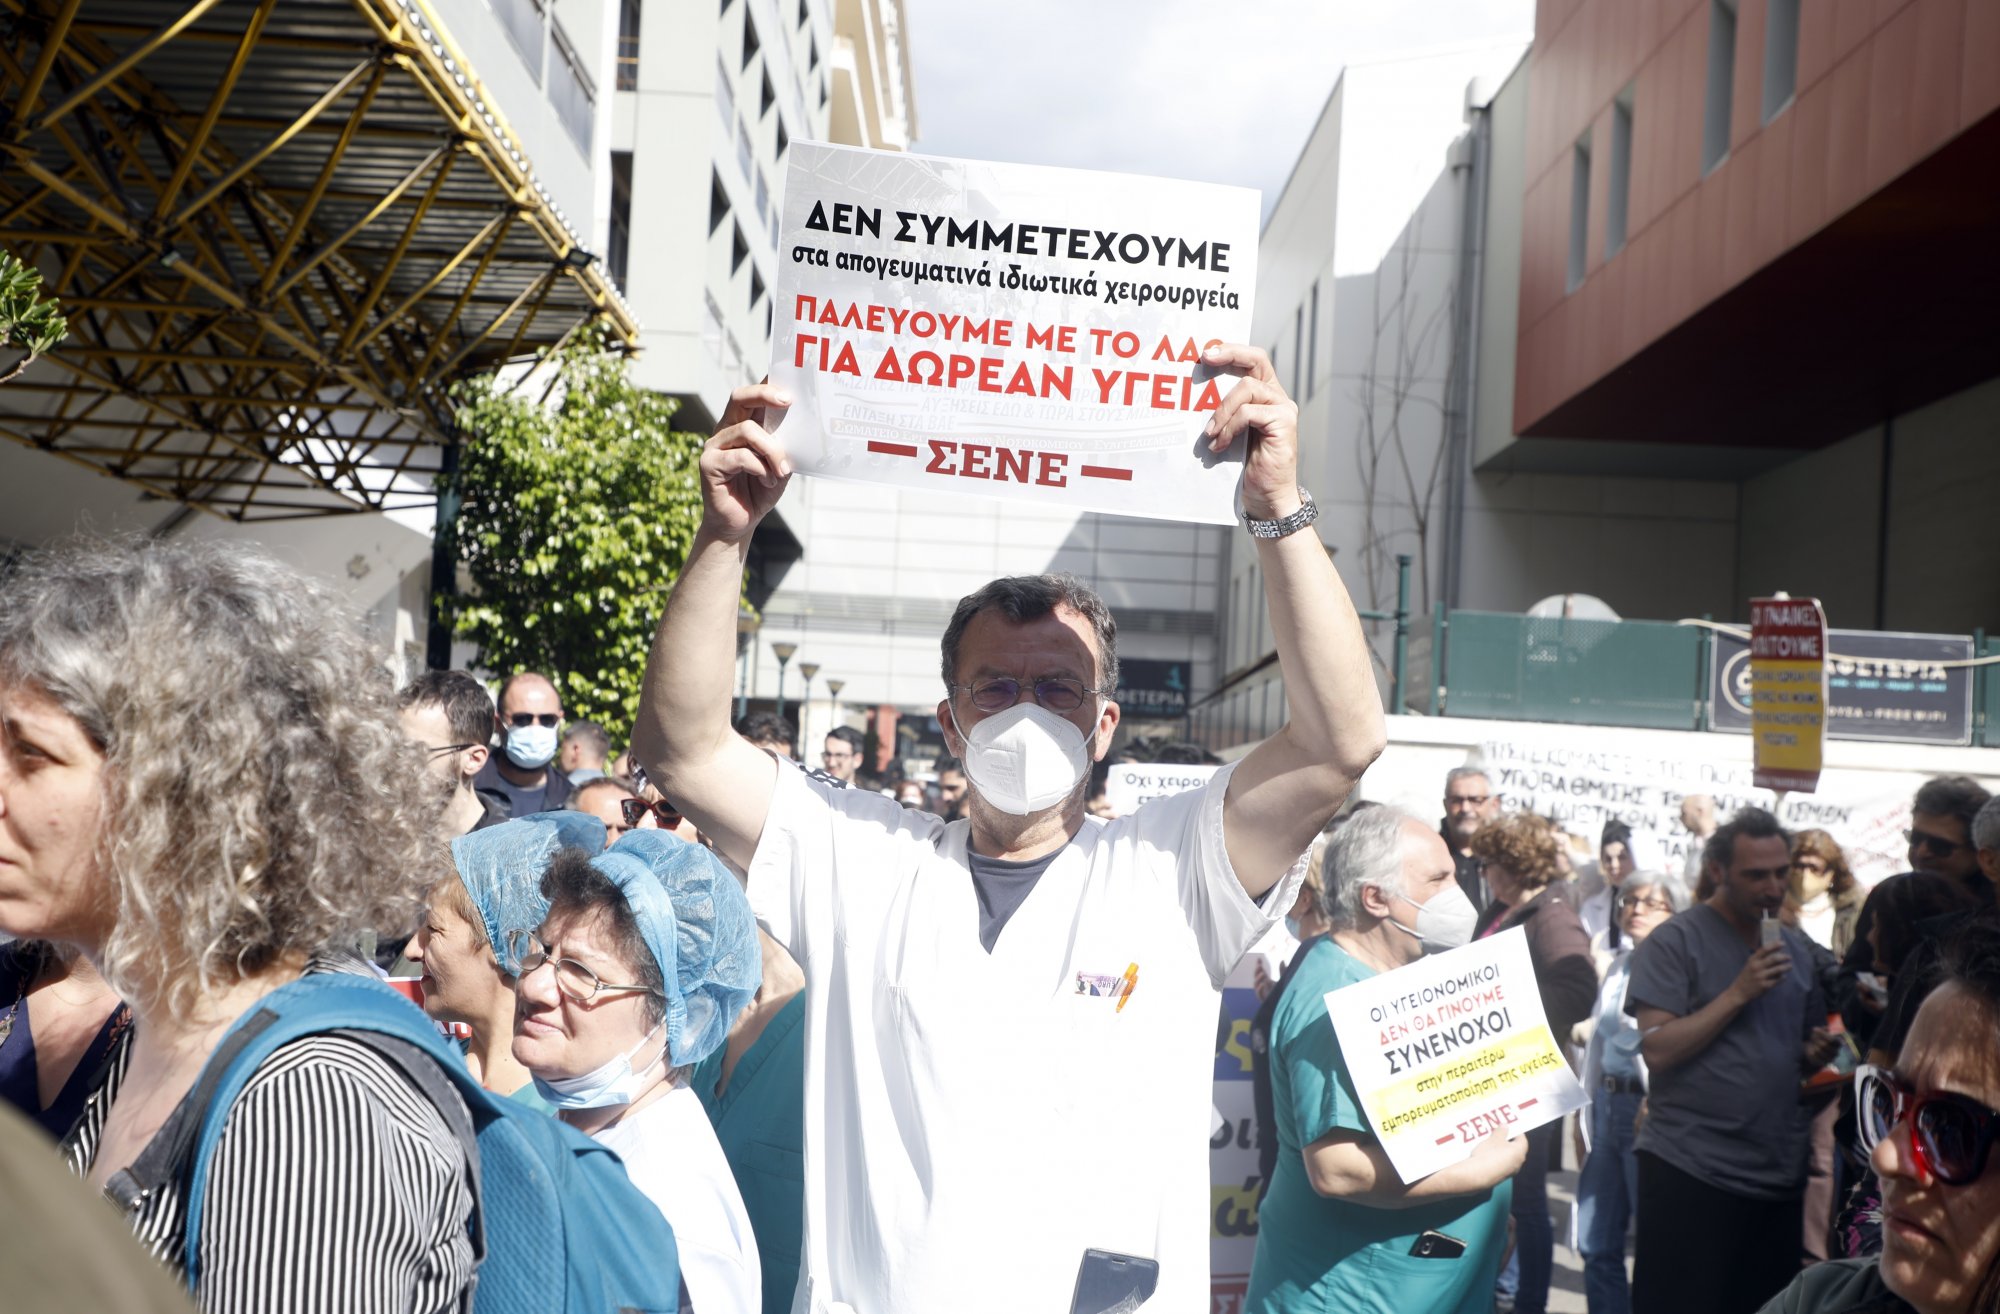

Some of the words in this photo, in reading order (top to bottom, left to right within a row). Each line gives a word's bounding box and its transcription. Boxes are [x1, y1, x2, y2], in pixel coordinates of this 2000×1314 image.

[805, 199, 882, 239] ΔΕΝ
[894, 211, 1231, 273] ΣΥΜΜΕΤΕΧΟΥΜΕ
[791, 244, 829, 268] στα
[836, 252, 992, 287] απογευματινά
[1000, 262, 1098, 296] ιδιωτικά
[1104, 279, 1240, 311] χειρουργεία
[794, 294, 1012, 347] ΠΑΛΕΥΟΥΜΕ
[1026, 324, 1077, 354] ΜΕ
[1090, 328, 1140, 359] ΤΟ
[794, 333, 867, 377] ΓΙΑ
[874, 345, 1073, 400] ΔΩΡΕΑΝ
[1091, 368, 1225, 412] ΥΓΕΙΑ
[843, 404, 895, 425] ΕΝΤΑΞΗ
[926, 439, 1069, 488] ΣΕΝΕ
[1370, 1004, 1388, 1023] ΟΙ
[1392, 963, 1500, 1015] ΥΓΕΙΟΝΟΜΙΚΟΙ
[1379, 1020, 1410, 1046] ΔΕΝ
[1413, 1014, 1437, 1032] ΘΑ
[1438, 985, 1505, 1021] ΓΙΝΟΥΜΕ
[1384, 1007, 1513, 1075] ΣΥΝΕΝΟΧΟΙ
[1416, 1075, 1443, 1093] στην
[1446, 1048, 1506, 1083] περαιτέρω
[1382, 1076, 1497, 1132] εμπορευματοποίηση
[1498, 1066, 1519, 1084] της
[1521, 1050, 1558, 1079] υγείας
[1456, 1104, 1518, 1142] ΣΕΝΕ
